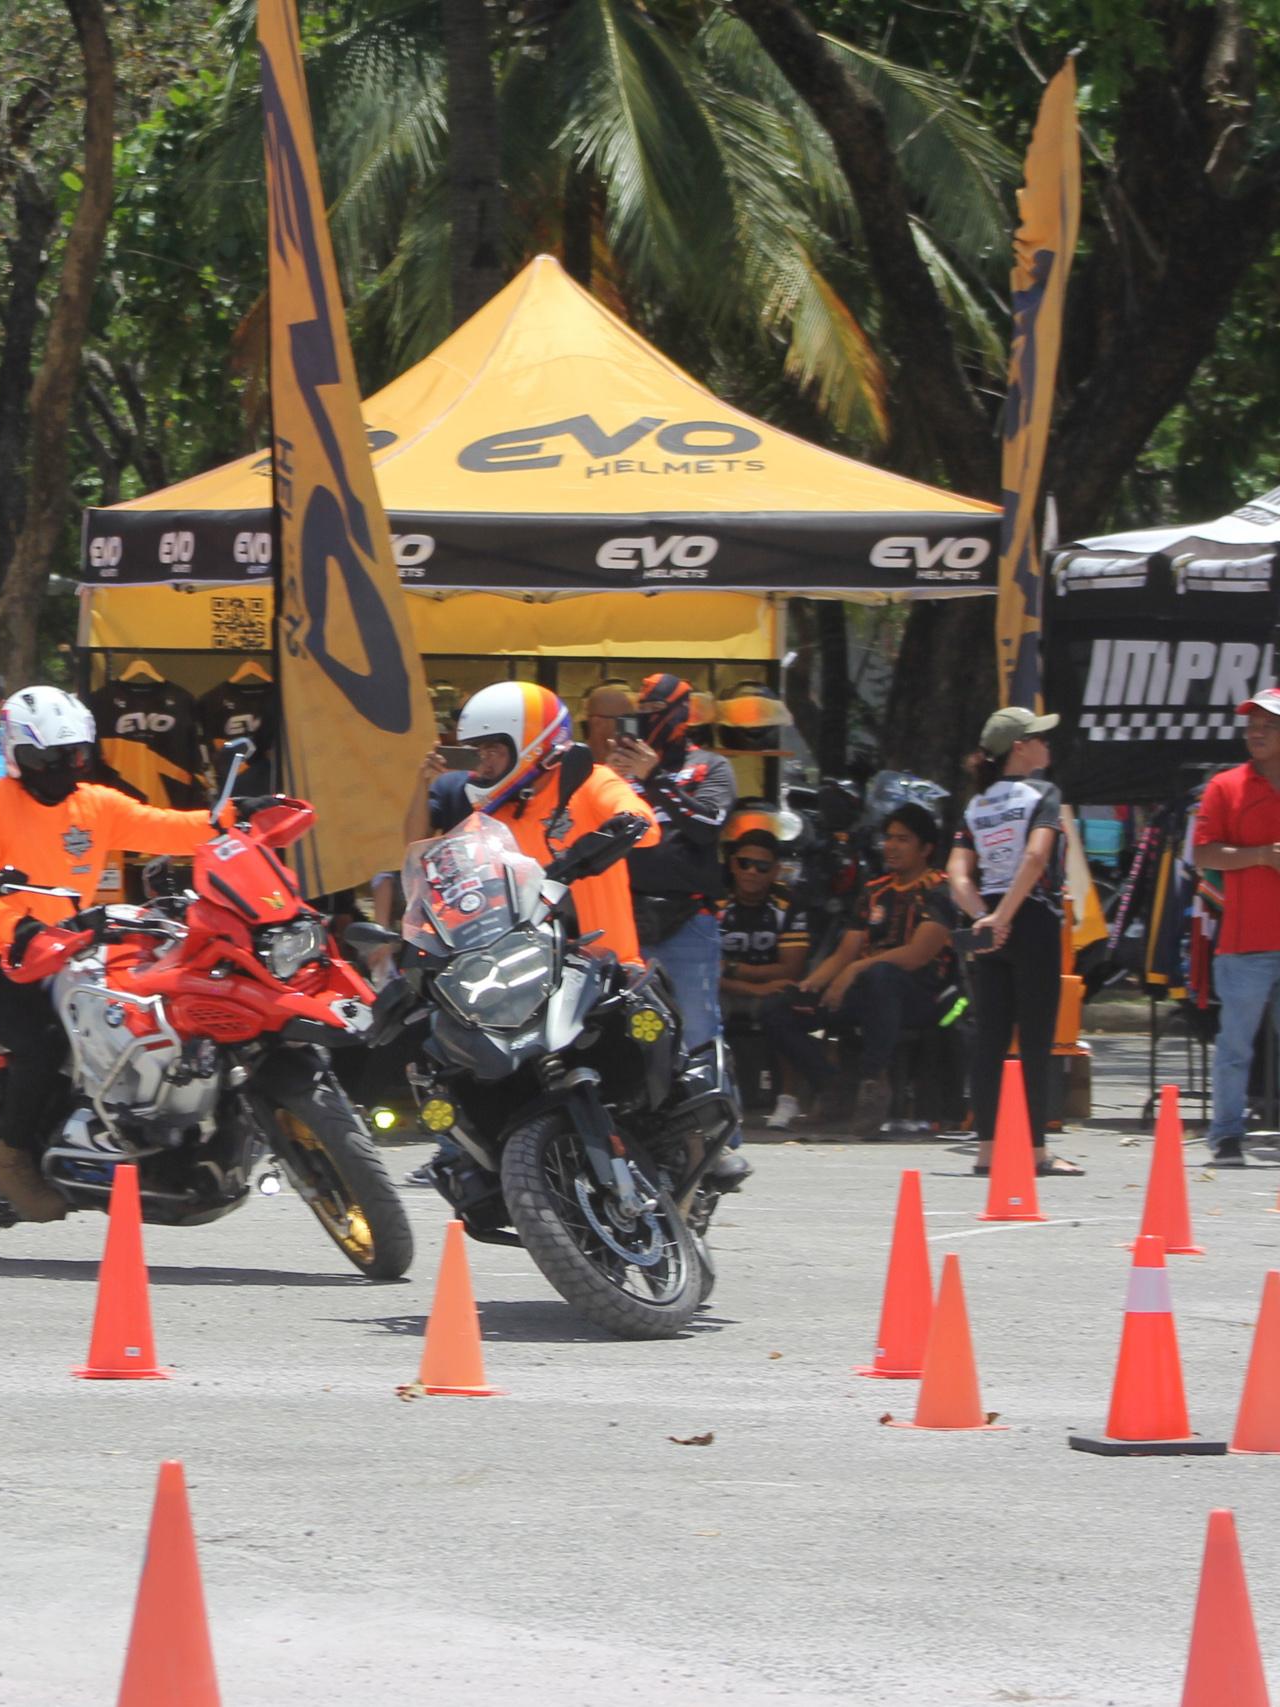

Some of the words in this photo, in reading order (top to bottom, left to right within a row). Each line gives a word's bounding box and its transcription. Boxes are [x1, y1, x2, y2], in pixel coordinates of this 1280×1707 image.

[457, 413, 762, 474] EVO
[585, 458, 767, 479] HELMETS
[595, 535, 719, 569] EVO
[869, 536, 991, 569] EVO
[642, 568, 708, 579] HELMETS
[916, 570, 981, 580] HELMETS
[116, 712, 176, 734] EVO
